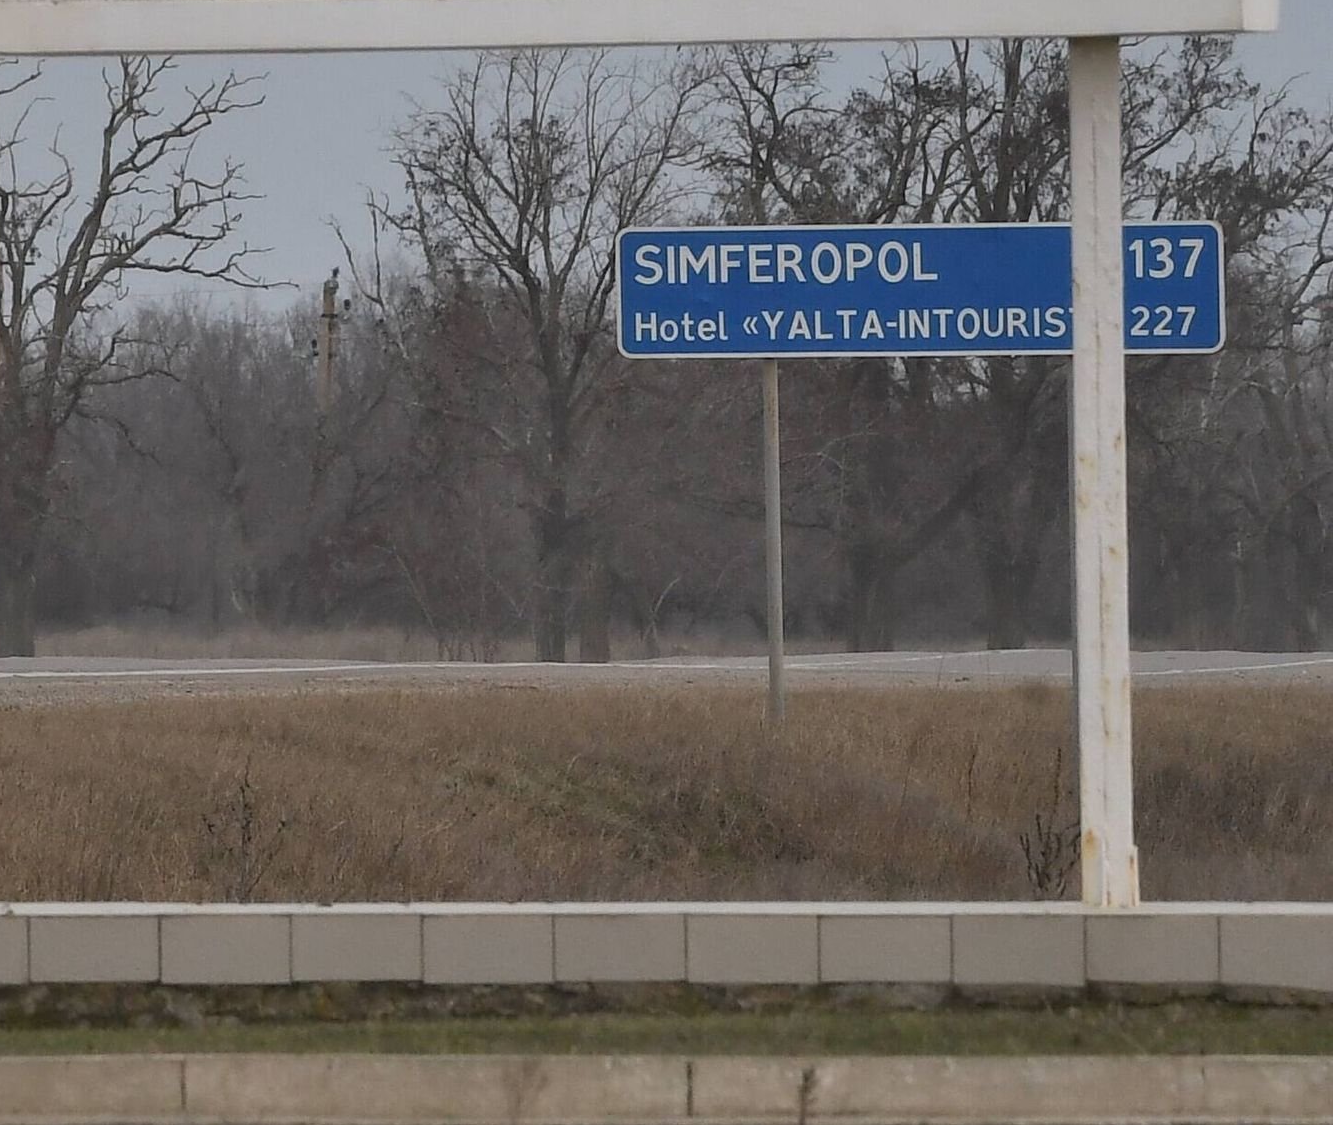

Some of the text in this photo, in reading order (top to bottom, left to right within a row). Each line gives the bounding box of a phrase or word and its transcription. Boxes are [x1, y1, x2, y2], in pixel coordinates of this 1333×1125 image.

[633, 238, 1206, 285] SIMFEROPOL 137
[634, 305, 1197, 342] Hotel «YALTA-INTOURIS 227
